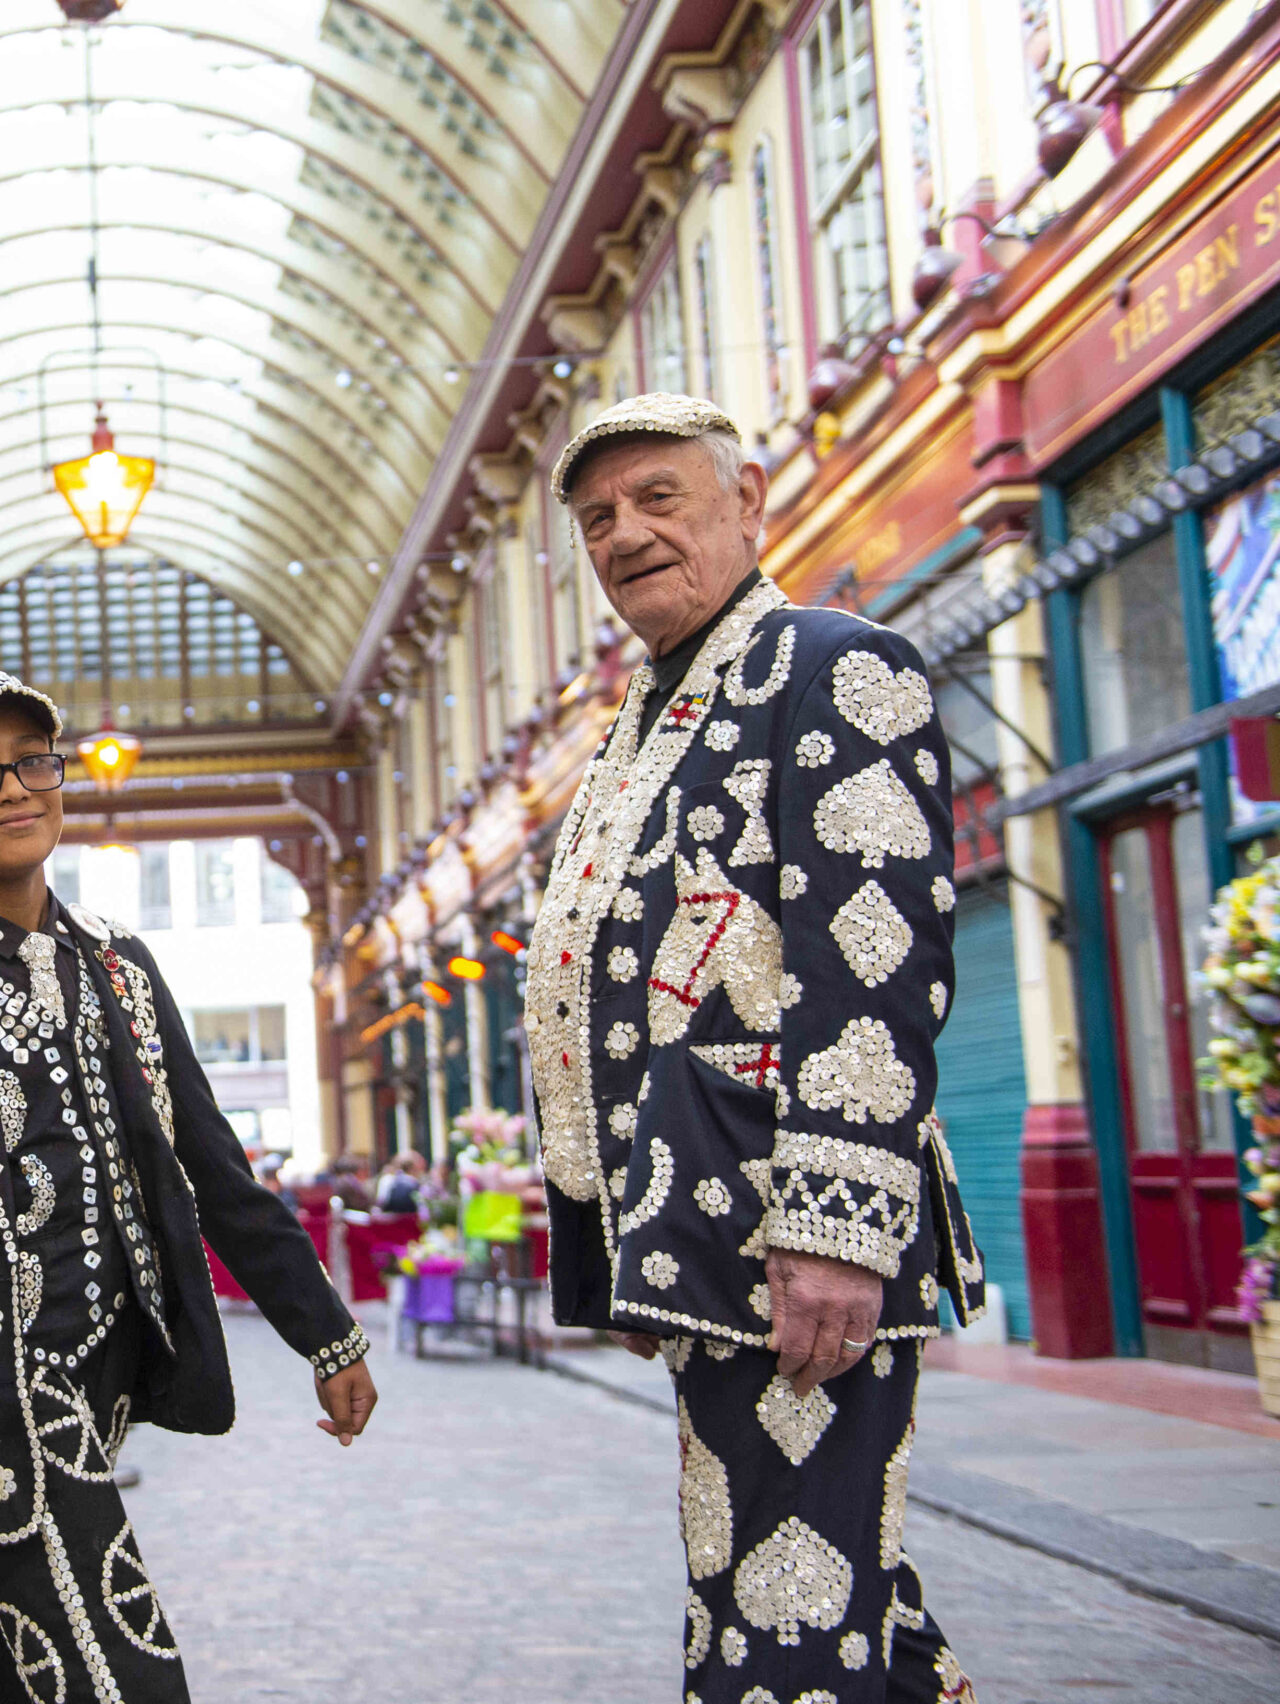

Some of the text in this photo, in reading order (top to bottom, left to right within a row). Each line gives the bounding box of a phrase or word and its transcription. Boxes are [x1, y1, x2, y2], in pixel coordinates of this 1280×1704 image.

[1109, 184, 1280, 363] THE PEN S
